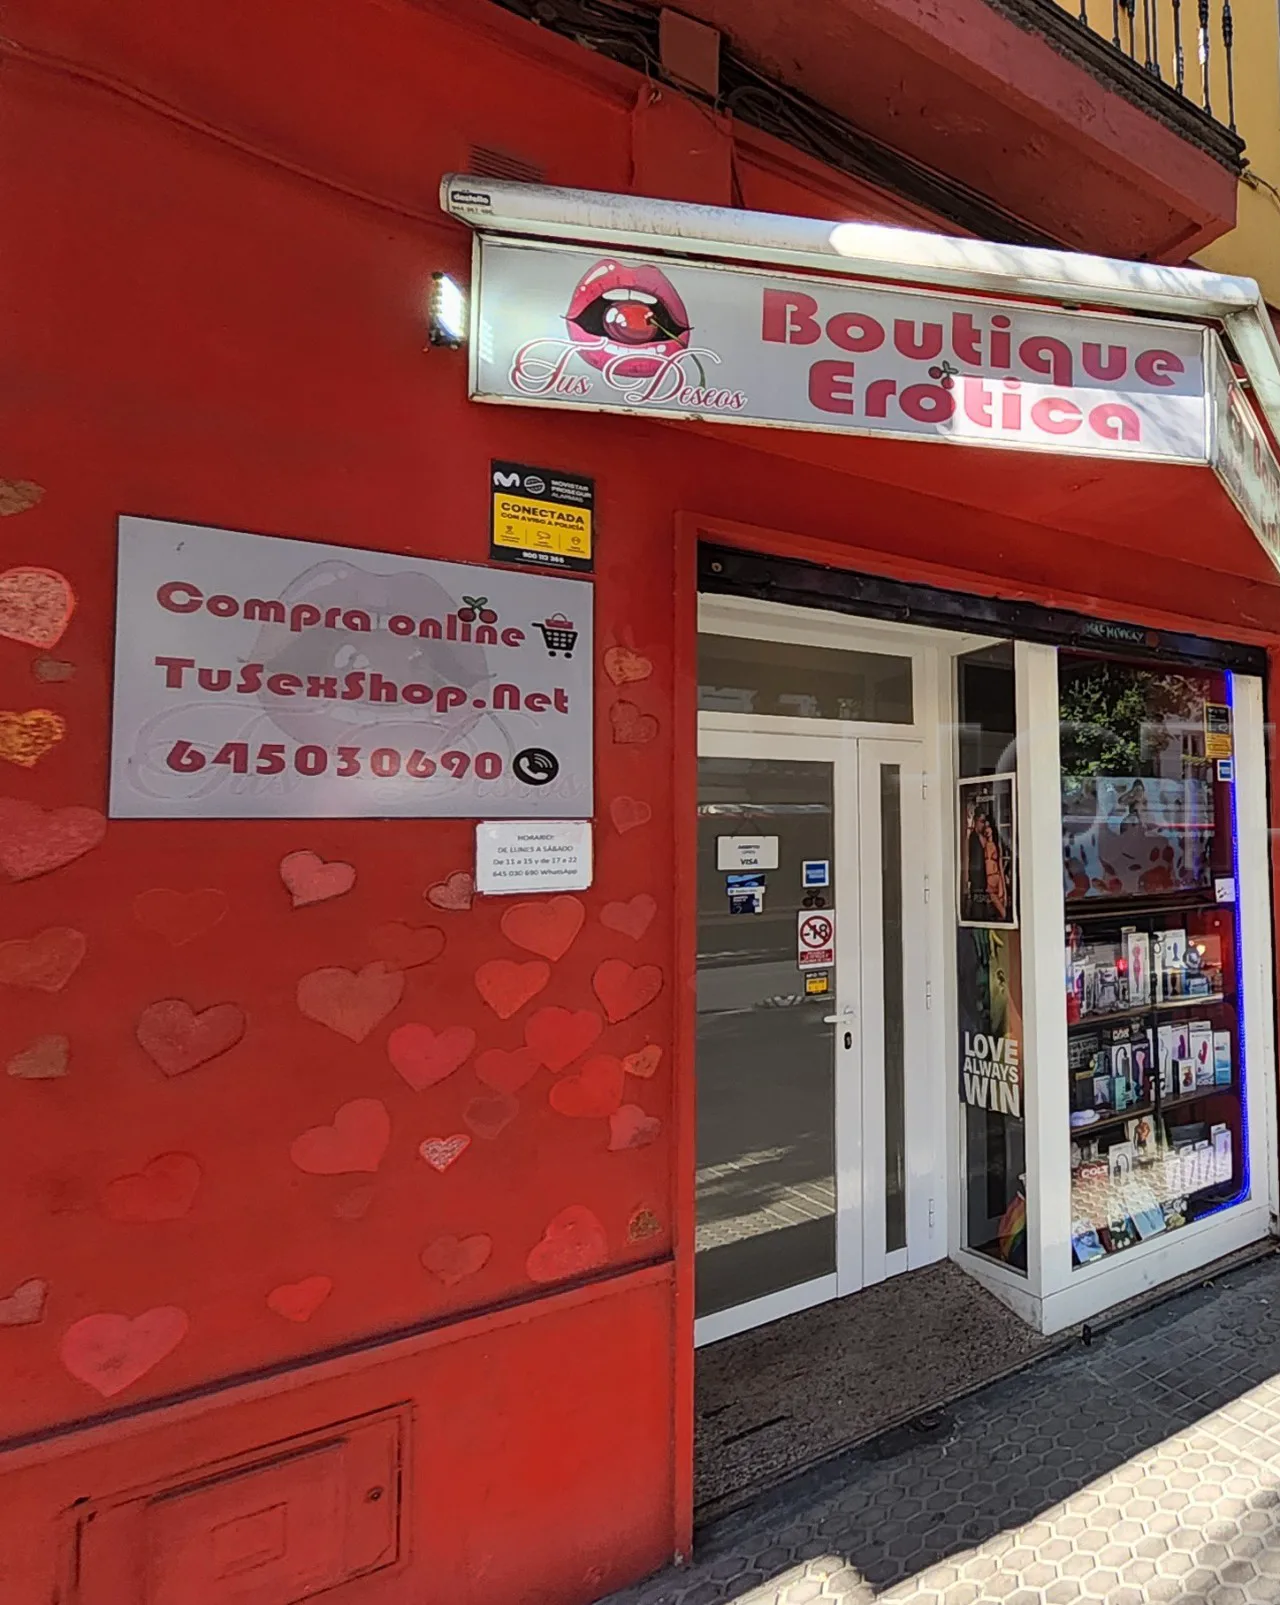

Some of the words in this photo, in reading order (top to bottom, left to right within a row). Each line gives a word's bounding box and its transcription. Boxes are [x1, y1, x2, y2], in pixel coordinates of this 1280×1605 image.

[761, 287, 1185, 388] Boutique
[509, 337, 608, 396] Tus
[602, 347, 748, 412] Deseos
[501, 502, 584, 524] CONECTADA
[501, 512, 519, 521] CON
[522, 516, 546, 525] AVISO
[156, 581, 372, 632] Compra
[388, 611, 526, 648] online
[155, 655, 569, 715] TuSexShop.Net
[166, 739, 503, 780] 645030690
[740, 858, 759, 866] VISA
[804, 923, 828, 941] -18
[964, 1031, 1019, 1066] LOVE
[963, 1056, 1019, 1084] ALWAYS
[963, 1072, 1020, 1118] WIN
[1081, 1165, 1109, 1178] COLT
